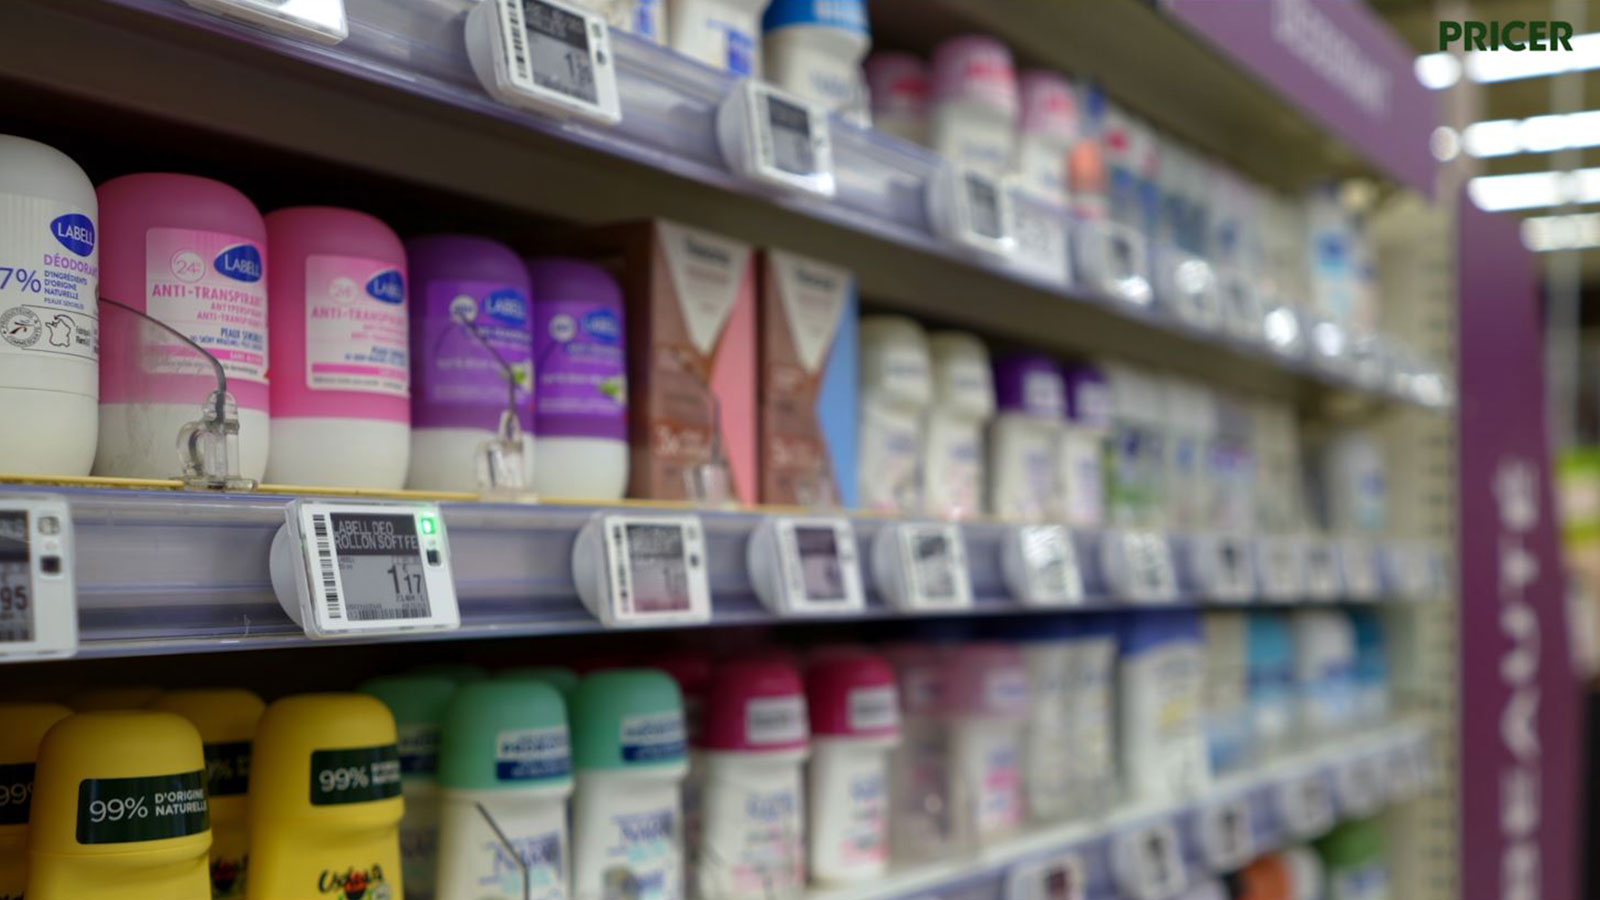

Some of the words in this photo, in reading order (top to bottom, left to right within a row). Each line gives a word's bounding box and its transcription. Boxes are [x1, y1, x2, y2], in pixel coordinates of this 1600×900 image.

[58, 222, 94, 246] LABELL
[224, 254, 260, 276] LABELL
[44, 287, 79, 300] NATURELLE
[372, 521, 394, 536] DEO
[335, 534, 377, 550] ROLLON
[378, 535, 404, 550] SOFT
[405, 535, 419, 549] FE
[318, 767, 369, 793] 99%
[155, 788, 204, 804] D'ORIGINE
[89, 796, 148, 822] 99%
